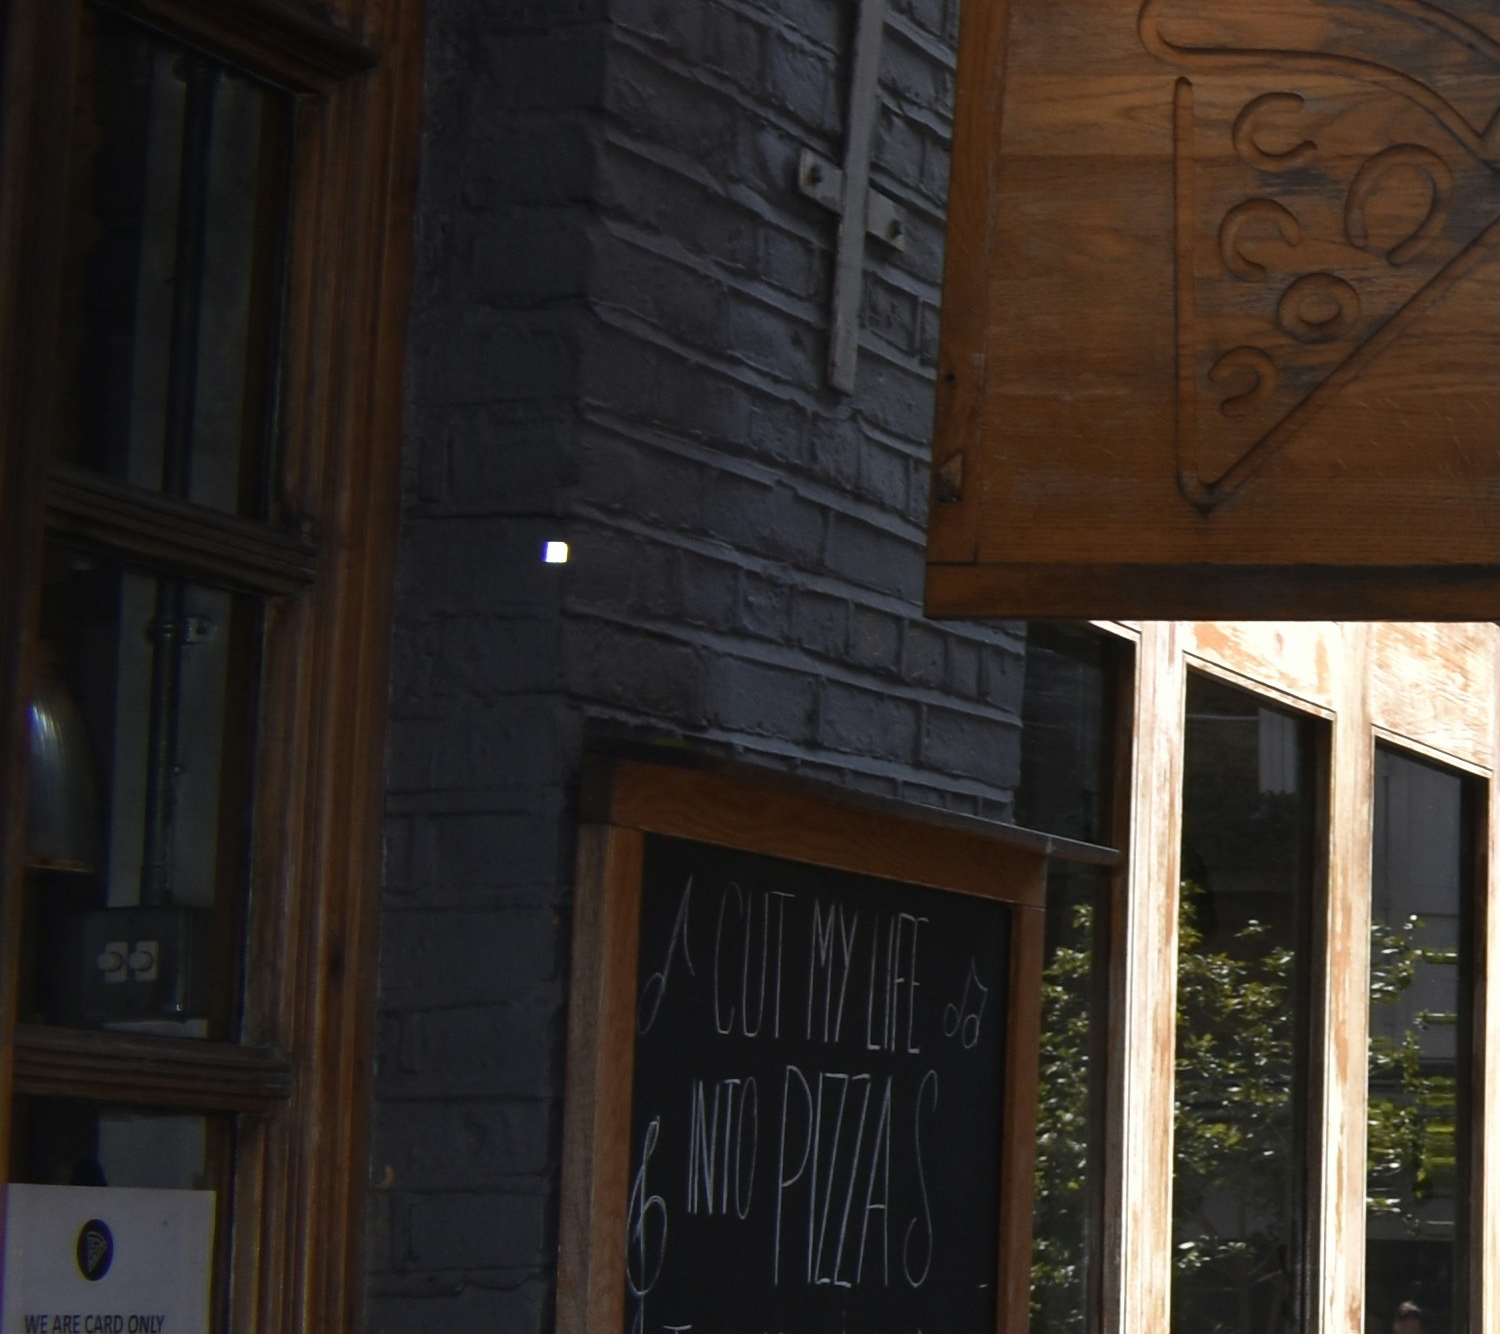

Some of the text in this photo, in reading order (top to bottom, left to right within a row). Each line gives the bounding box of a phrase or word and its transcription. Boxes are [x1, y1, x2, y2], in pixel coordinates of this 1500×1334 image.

[714, 880, 930, 1054] CUT MY LIFE
[687, 1075, 758, 1220] INTO
[24, 1314, 165, 1334] WE ARE CARD ONLY
